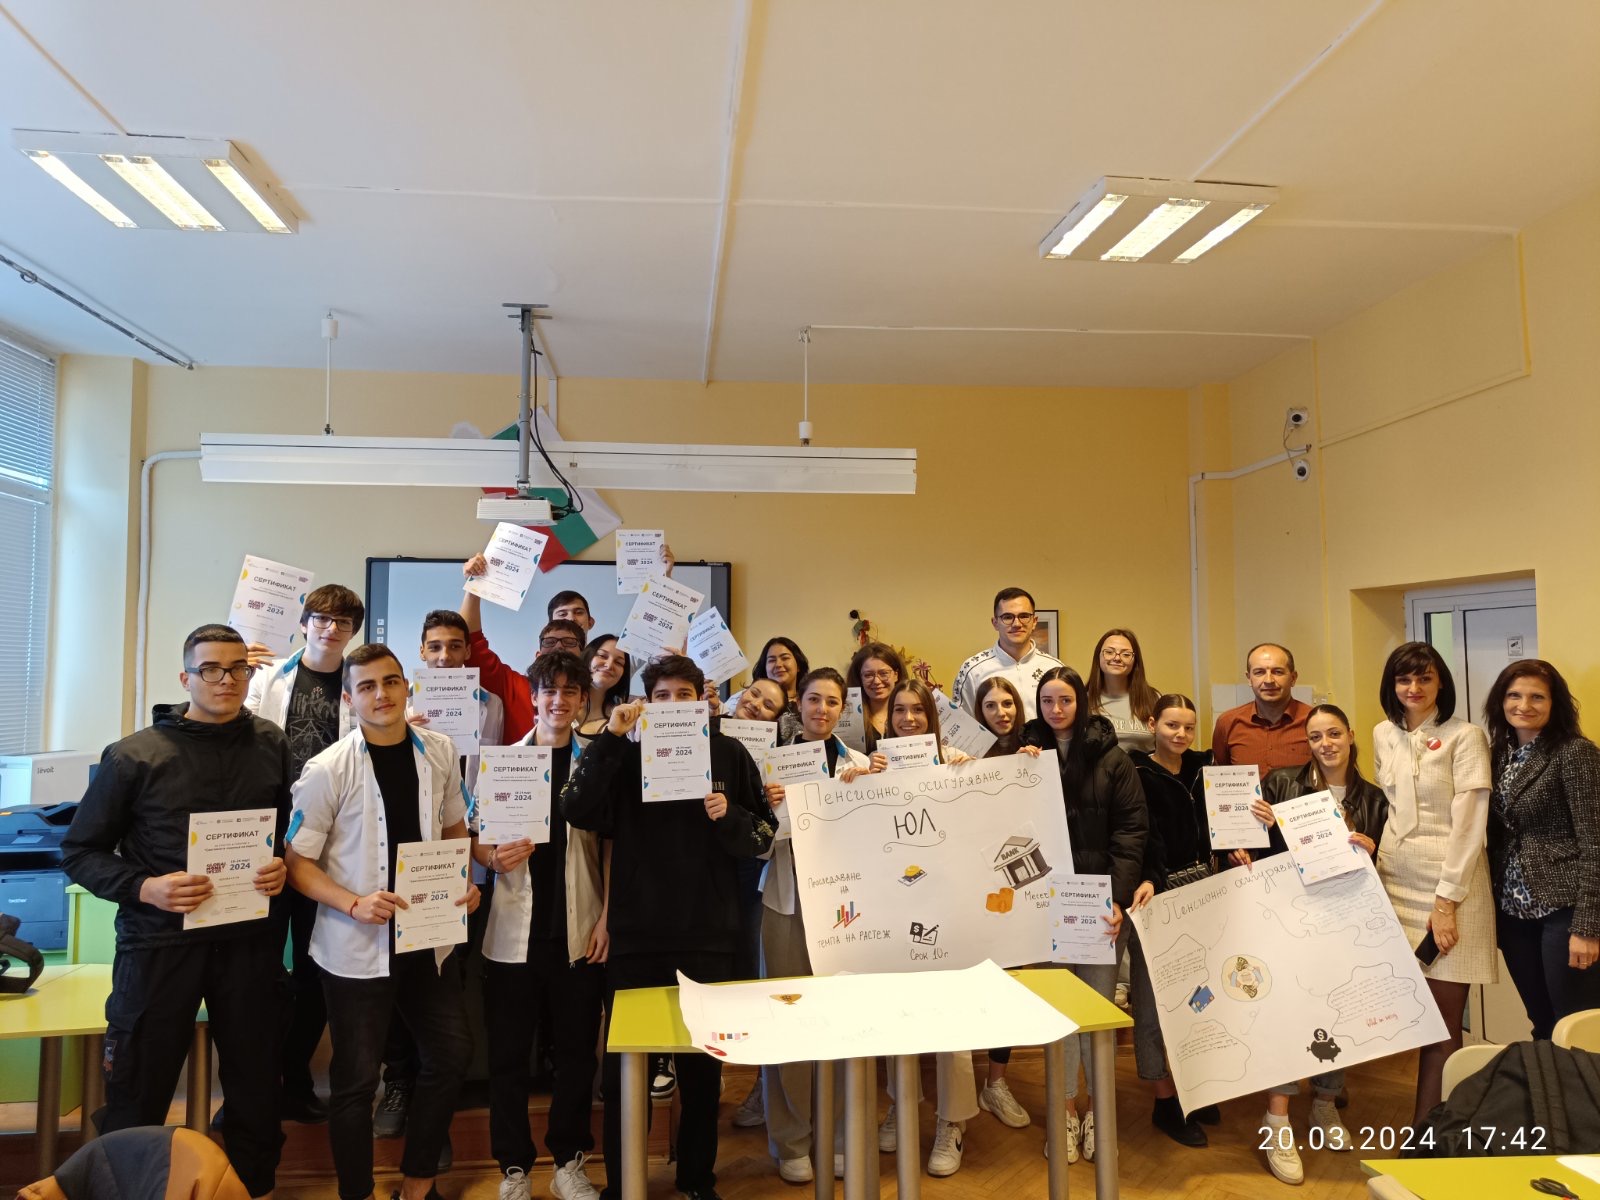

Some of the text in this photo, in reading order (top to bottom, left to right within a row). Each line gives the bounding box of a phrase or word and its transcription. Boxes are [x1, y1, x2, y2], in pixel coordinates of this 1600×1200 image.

[254, 576, 297, 592] СЕРТИФИКАТ
[266, 606, 284, 616] 2024
[658, 620, 672, 630] 2024
[778, 760, 816, 771] СЕРТИФИКАТ
[804, 782, 900, 810] Пенсионно
[894, 808, 936, 839] ЮЛ
[206, 830, 259, 841] СЕРТИФИКАТ
[1316, 831, 1332, 840] 2024
[1000, 846, 1020, 860] BANK
[230, 862, 251, 871] 2024
[411, 862, 456, 872] СЕРТИФИКАТ
[431, 893, 448, 901] 2024
